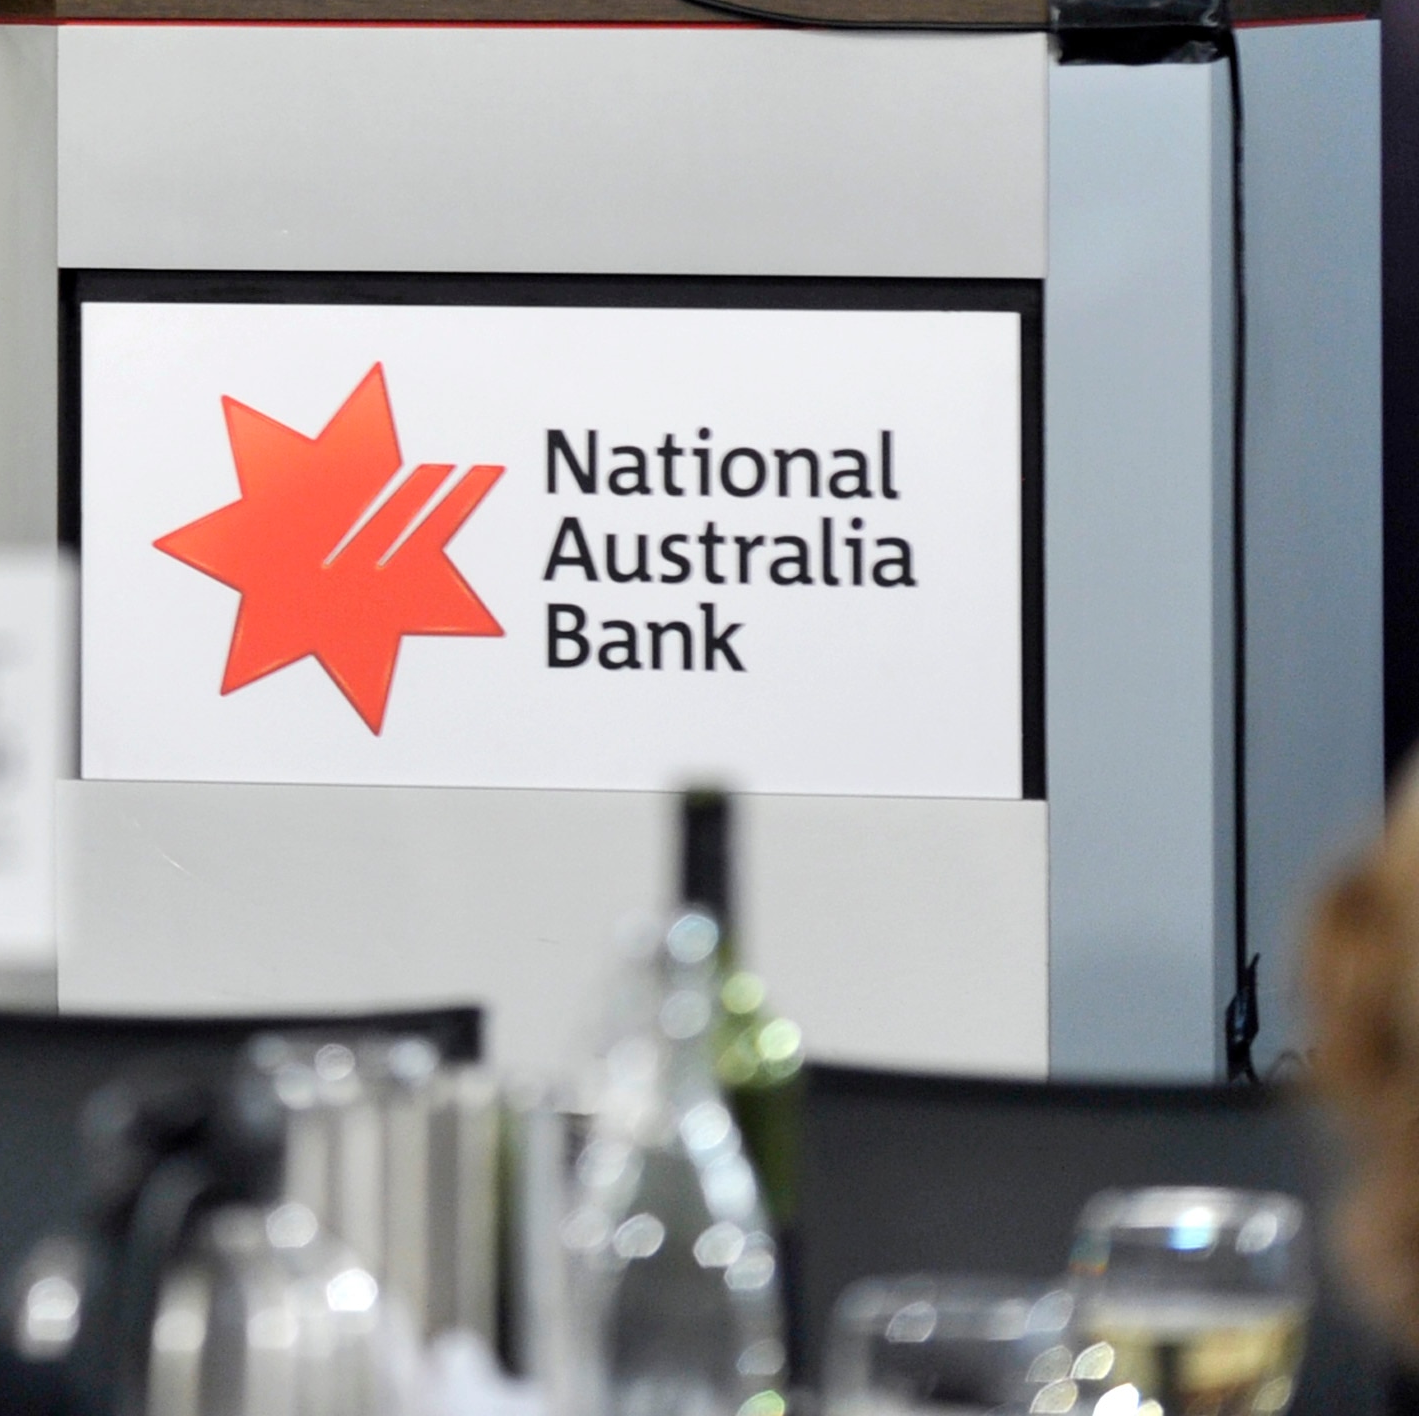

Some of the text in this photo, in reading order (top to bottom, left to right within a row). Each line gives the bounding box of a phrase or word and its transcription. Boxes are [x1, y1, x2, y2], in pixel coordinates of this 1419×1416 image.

[546, 426, 900, 501] National
[542, 515, 919, 589] Australia
[546, 601, 747, 673] Bank
